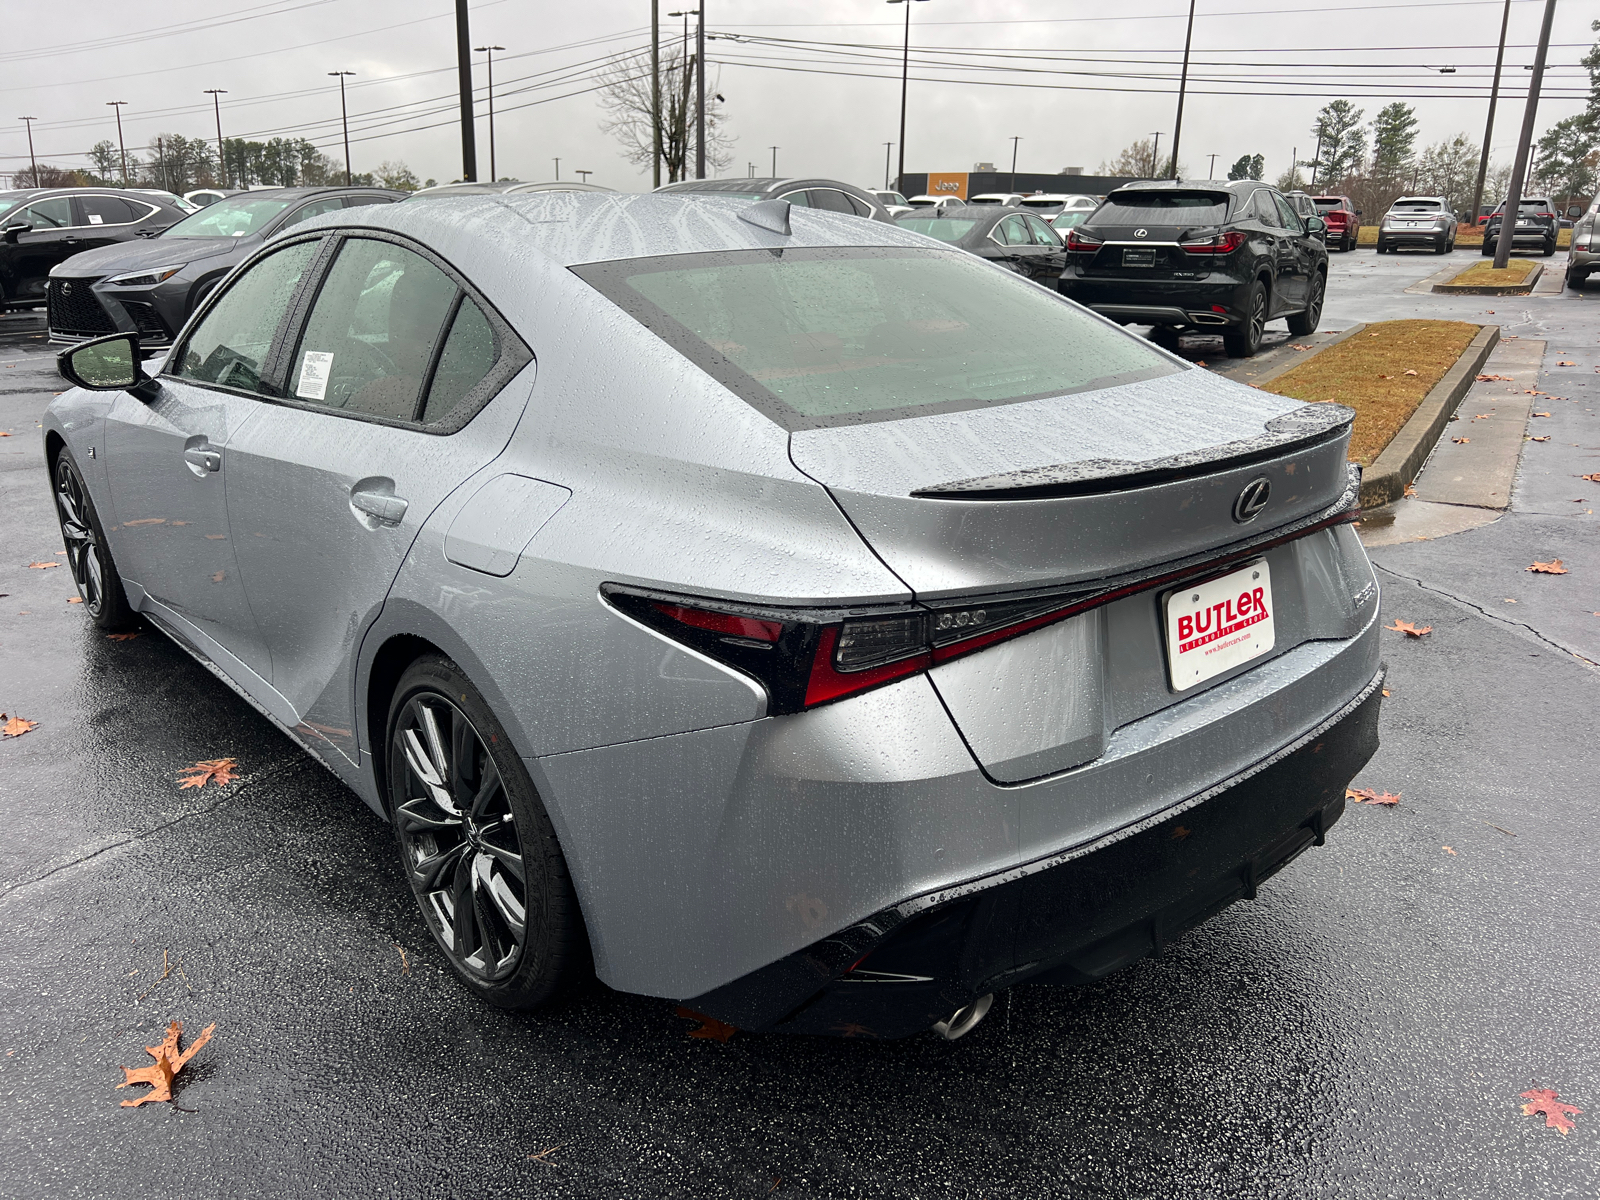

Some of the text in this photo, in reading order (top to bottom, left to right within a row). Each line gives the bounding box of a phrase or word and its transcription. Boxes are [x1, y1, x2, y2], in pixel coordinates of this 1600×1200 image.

[935, 180, 960, 193] Jeep
[1180, 611, 1267, 653] AUTOMOTIVE GROUP
[1204, 632, 1252, 656] www.butlercars.com
